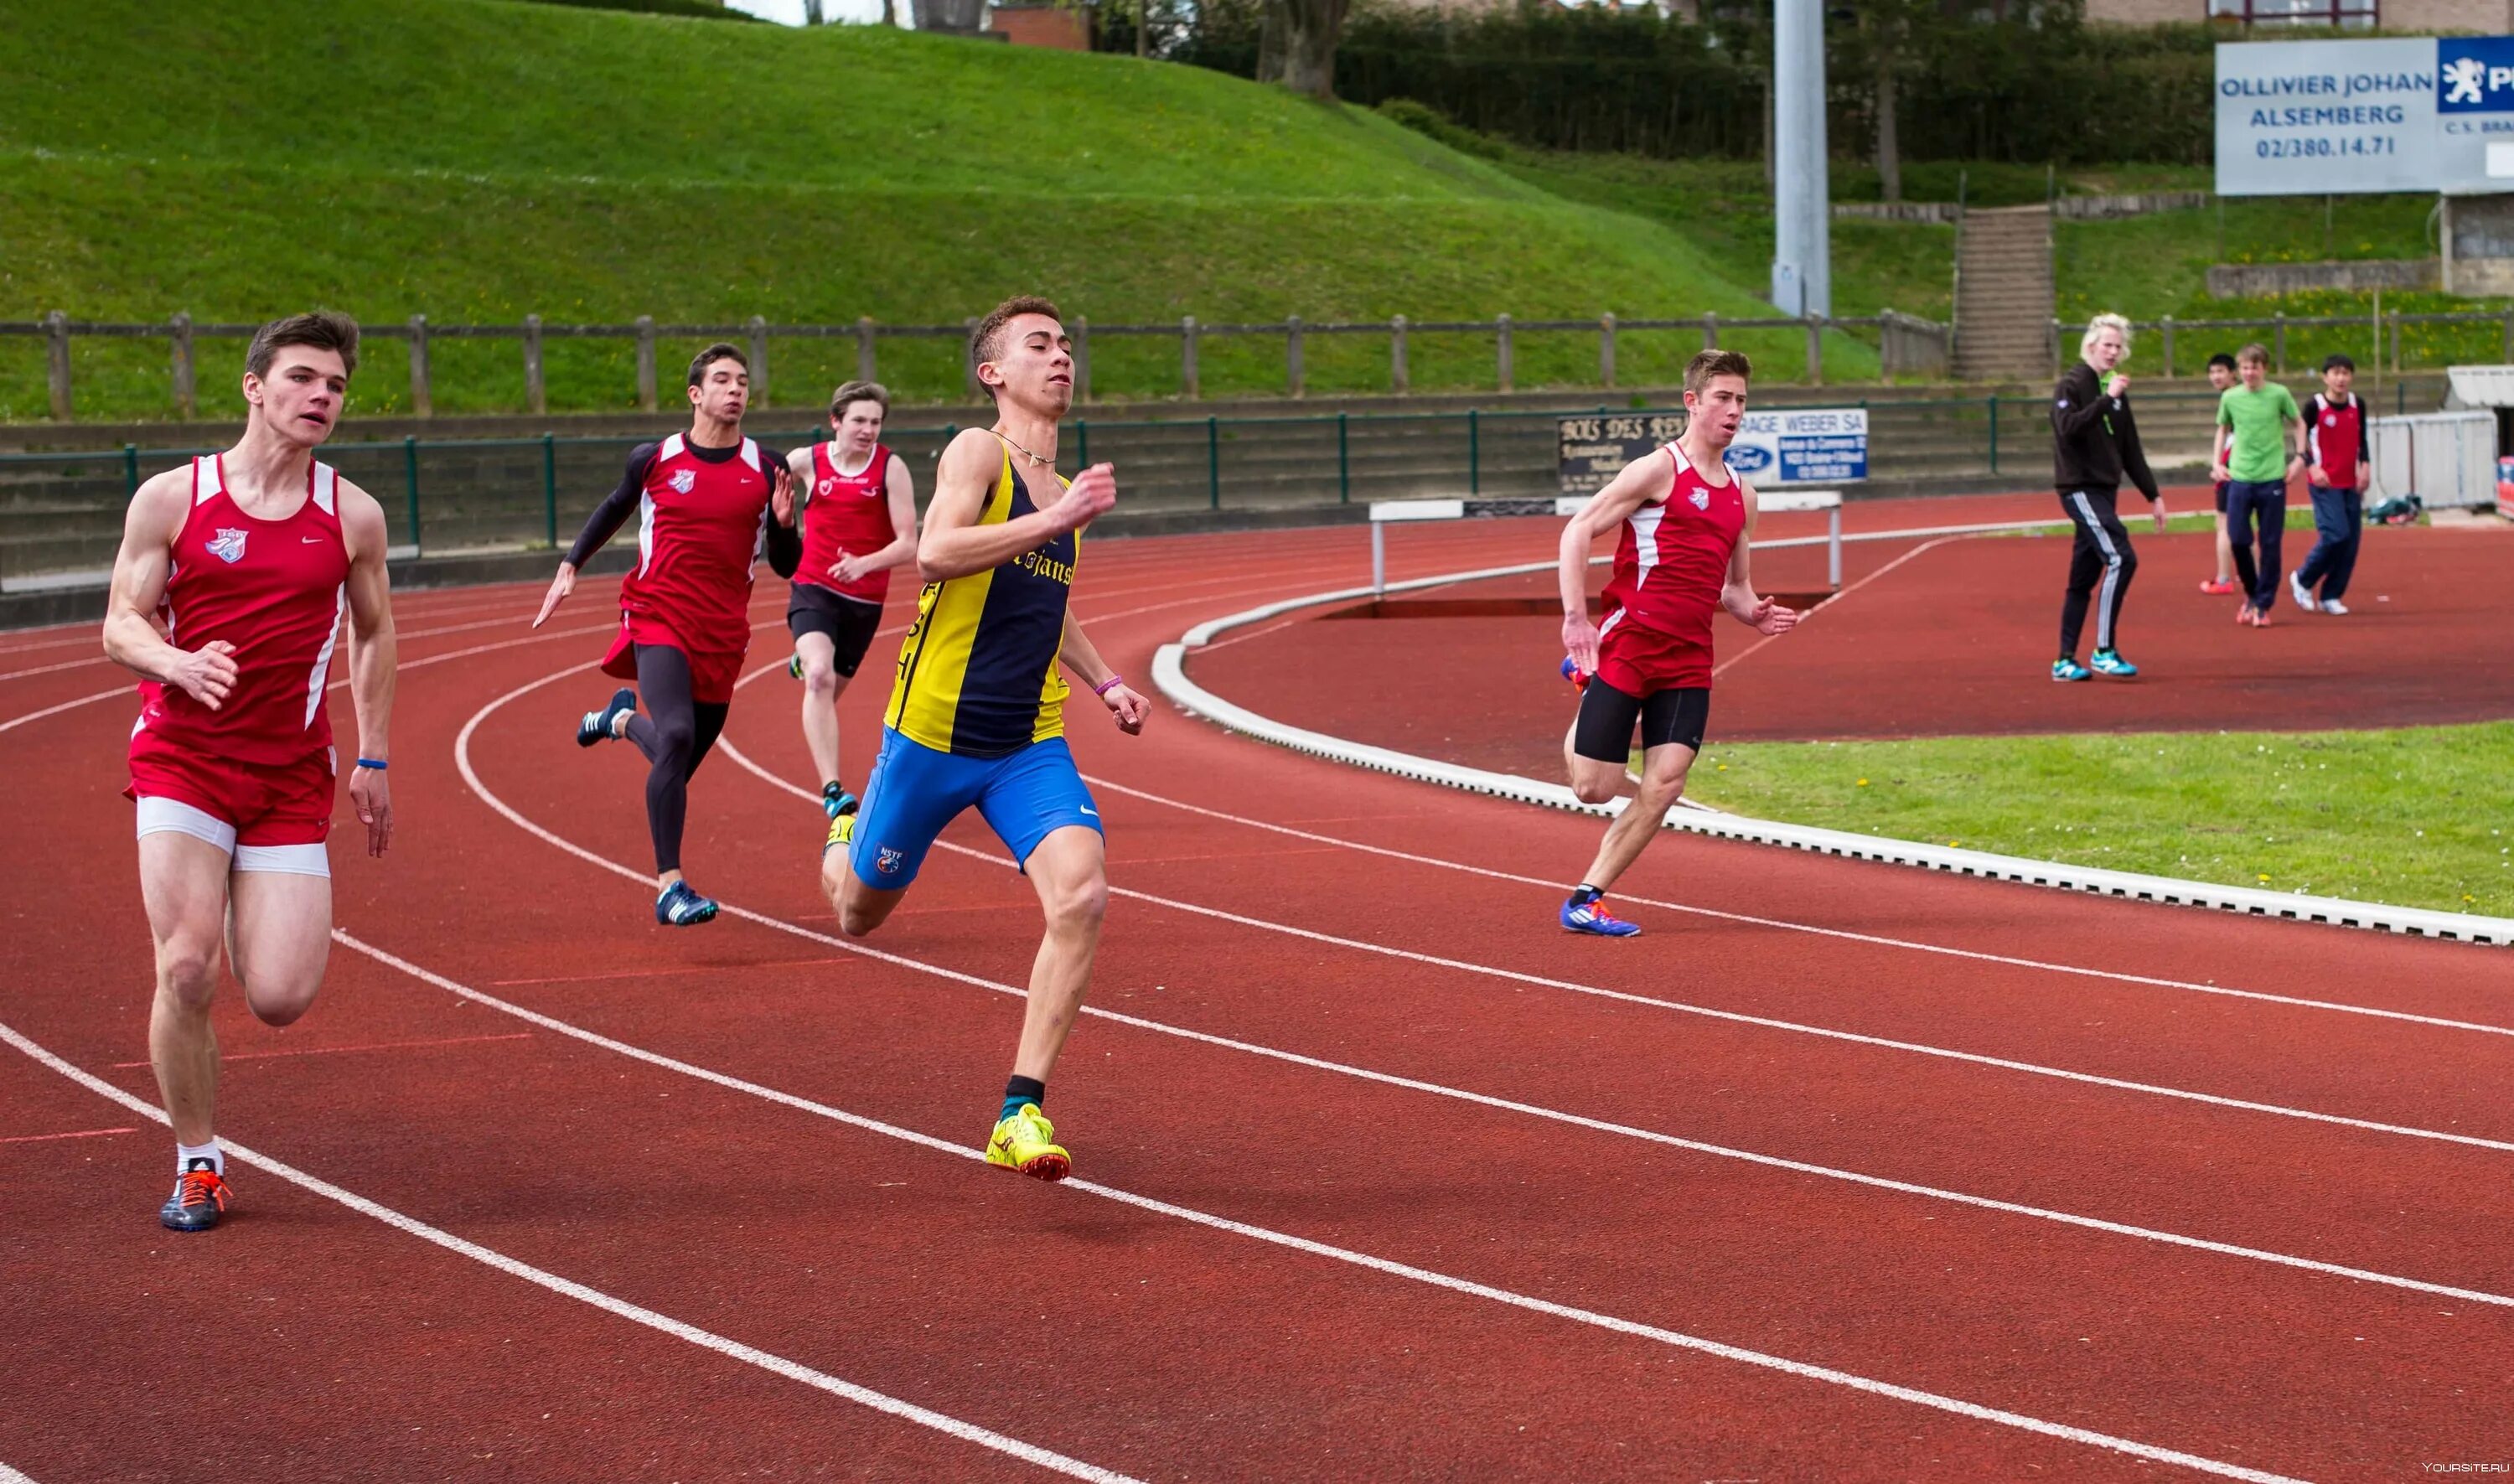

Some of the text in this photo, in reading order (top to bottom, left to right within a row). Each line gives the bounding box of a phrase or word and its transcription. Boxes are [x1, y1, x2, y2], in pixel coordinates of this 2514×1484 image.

[2221, 73, 2434, 98] OLLIVIER JOHAN
[2488, 67, 2514, 92] P
[2250, 106, 2403, 127] ALSEMBERG
[2257, 137, 2395, 158] 02/380.14.71
[1606, 418, 1644, 440] DES
[1785, 414, 1838, 432] WEBER
[1844, 413, 1863, 431] SA
